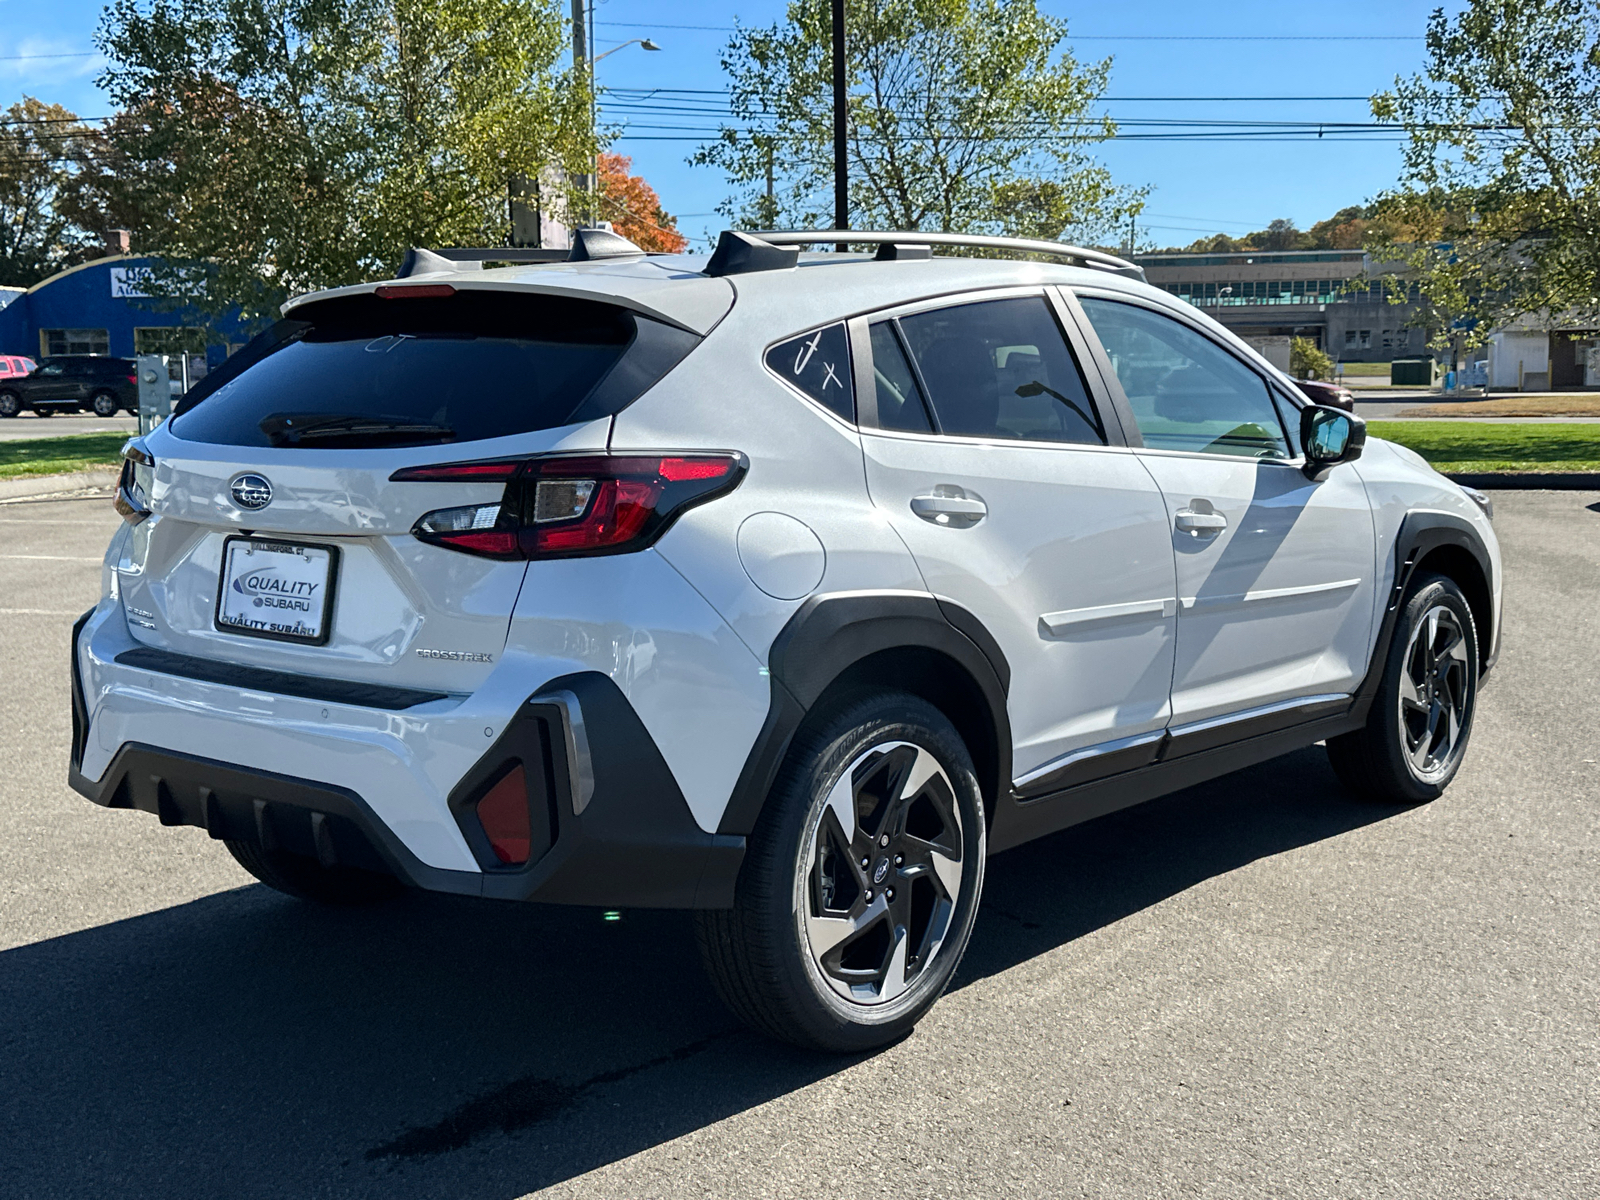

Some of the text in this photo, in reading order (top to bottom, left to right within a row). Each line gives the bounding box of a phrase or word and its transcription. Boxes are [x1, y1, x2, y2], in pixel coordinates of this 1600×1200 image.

[247, 576, 319, 596] QUALITY
[264, 597, 310, 612] SUBARU
[221, 616, 268, 630] QUALITY
[269, 622, 316, 636] SUBARU
[415, 648, 494, 663] CROSSTREK
